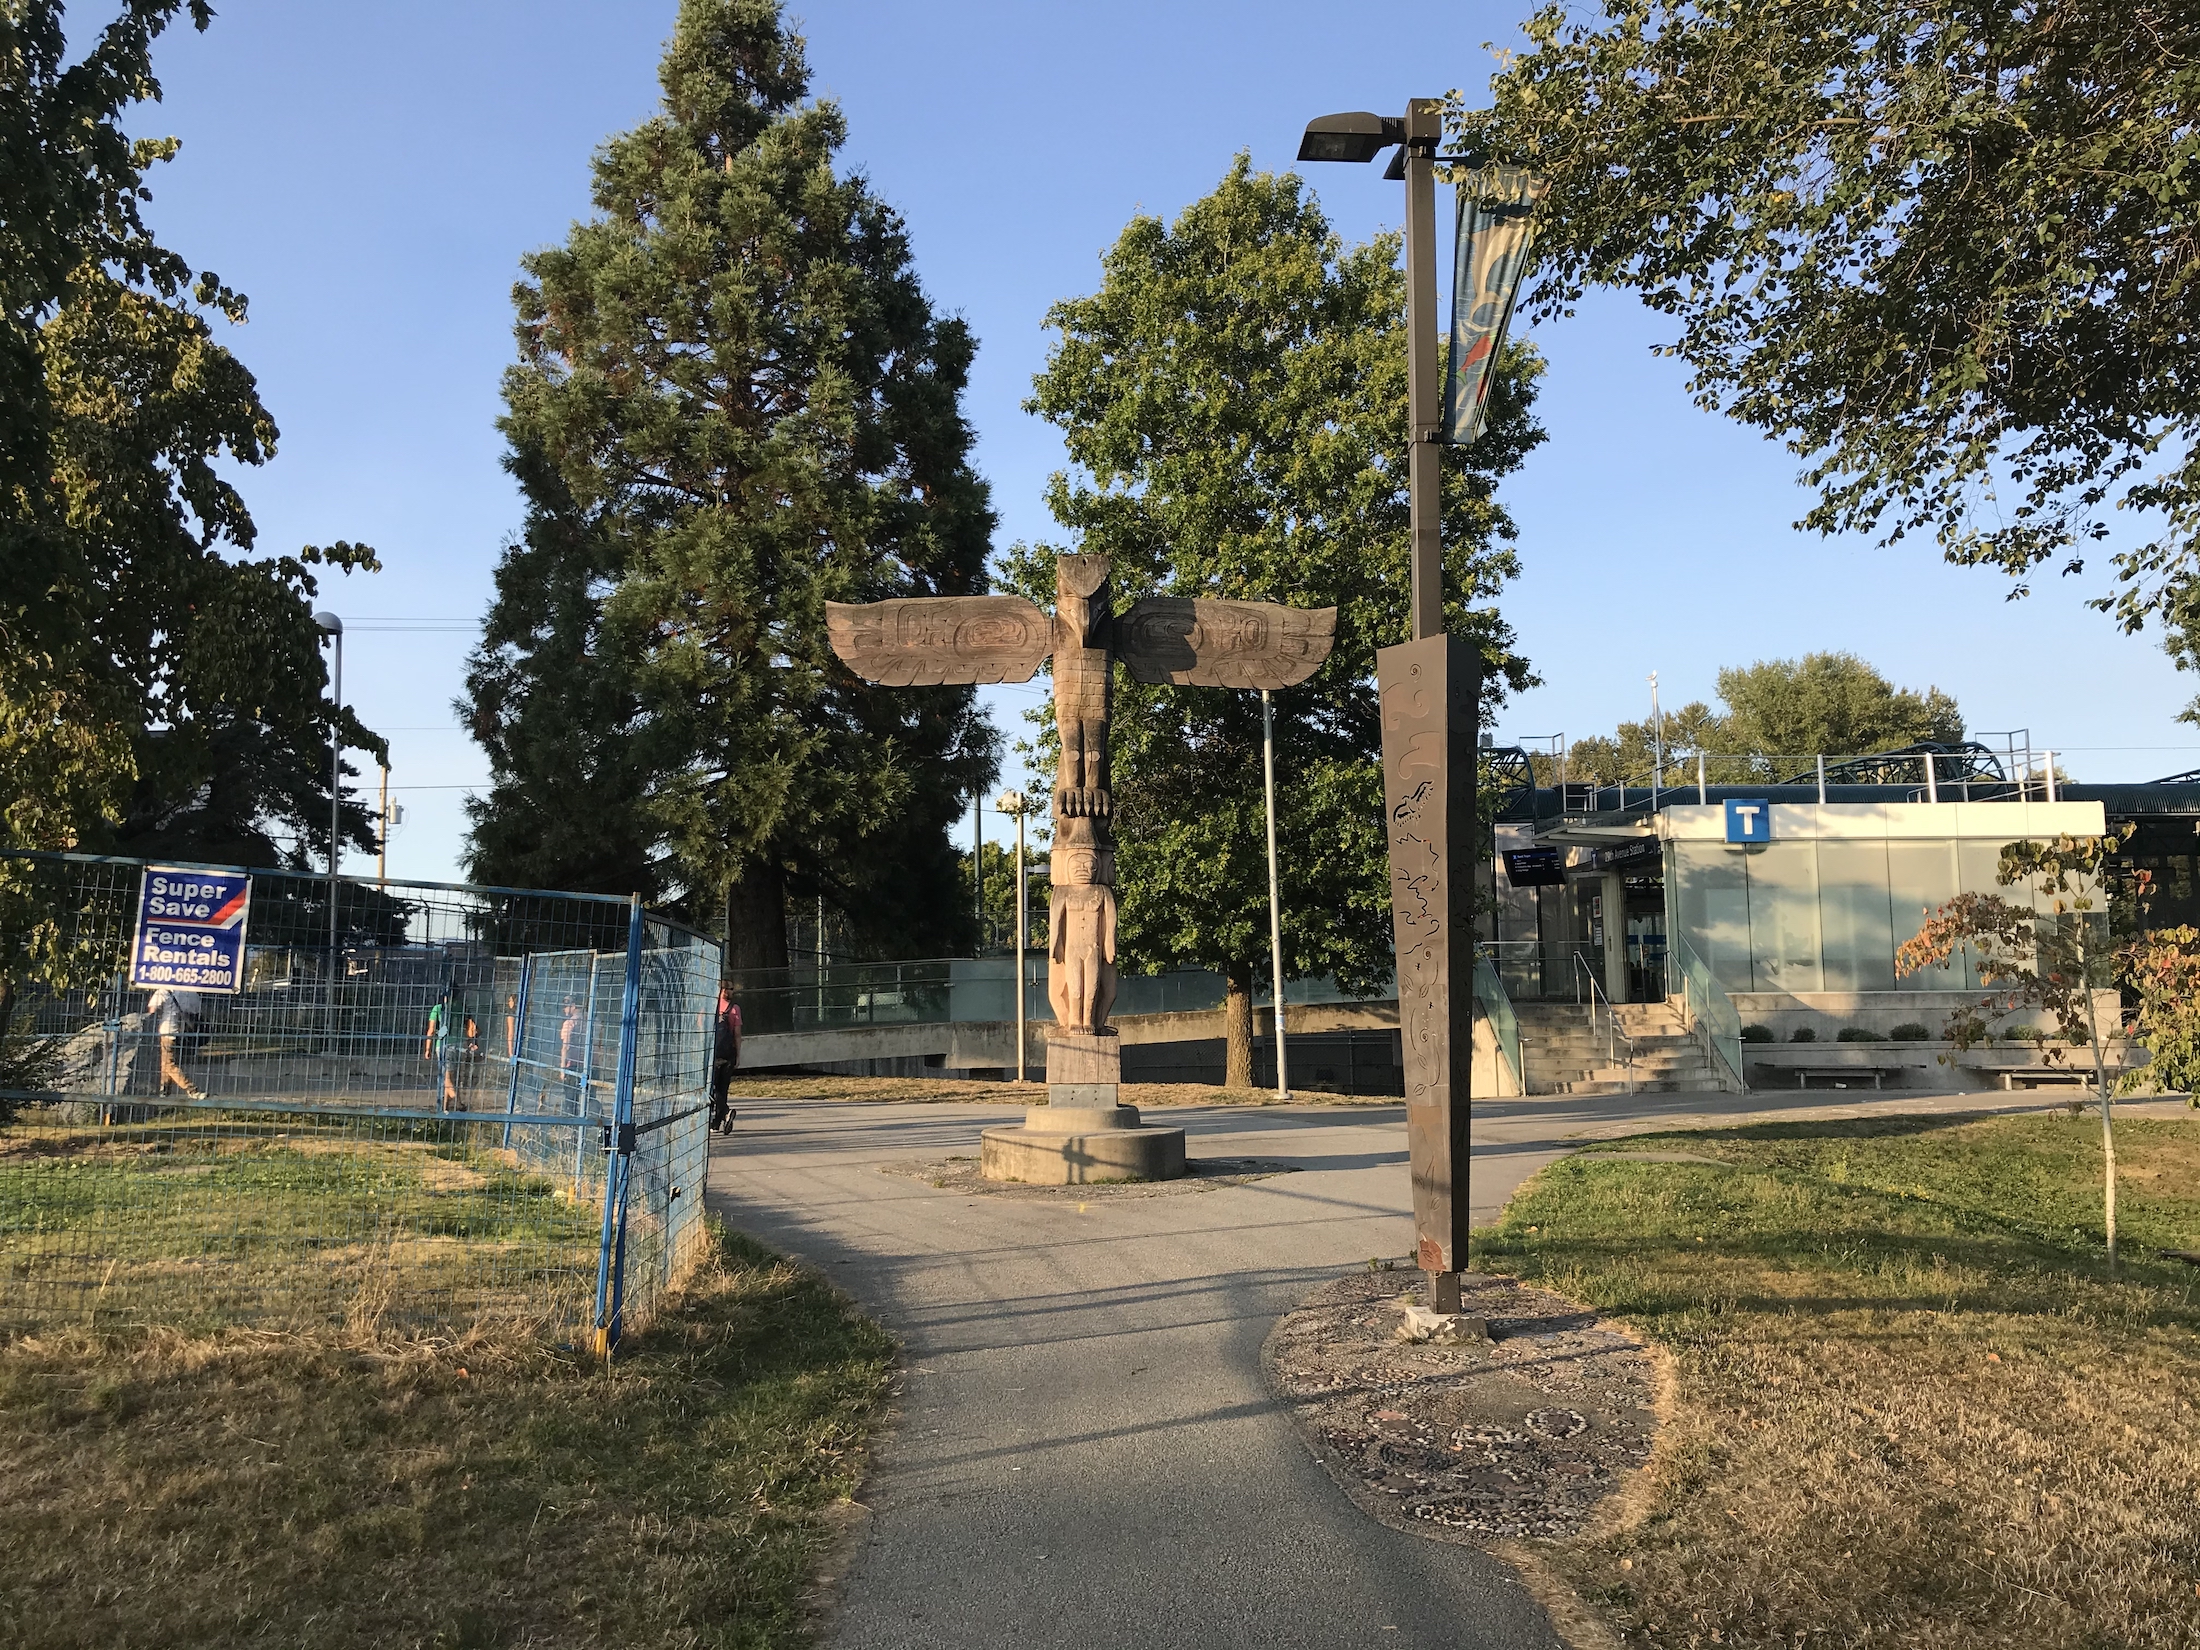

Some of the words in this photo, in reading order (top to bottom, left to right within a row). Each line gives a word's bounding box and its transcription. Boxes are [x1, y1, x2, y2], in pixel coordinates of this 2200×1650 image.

[1736, 806, 1760, 835] T
[1615, 848, 1629, 860] Avenue
[1629, 843, 1645, 856] Station
[152, 877, 227, 901] Super
[149, 897, 210, 918] Save
[145, 927, 215, 947] Fence
[143, 945, 231, 967] Rentals
[138, 965, 232, 986] 1-800-665-2800
